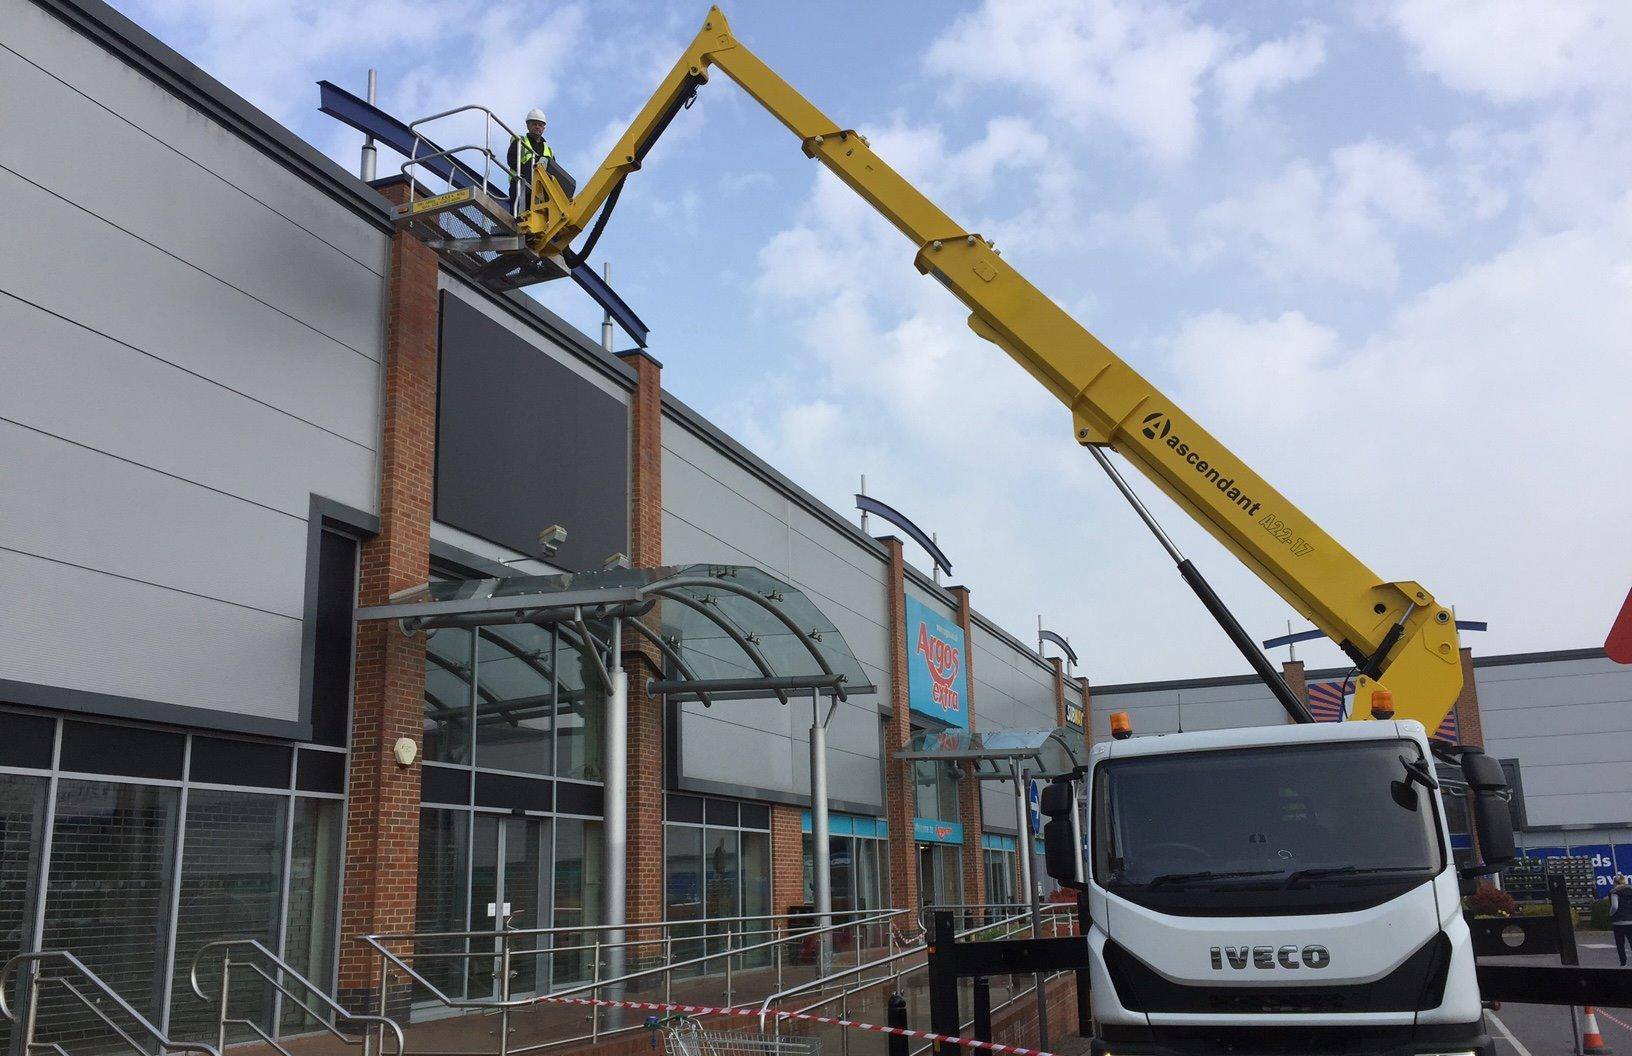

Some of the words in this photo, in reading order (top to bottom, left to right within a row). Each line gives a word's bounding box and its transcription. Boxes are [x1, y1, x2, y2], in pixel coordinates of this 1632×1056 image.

[1166, 435, 1263, 516] ascendant
[1258, 513, 1315, 557] A22-17
[916, 621, 959, 688] Argos
[933, 682, 958, 711] extra
[1210, 944, 1331, 970] IVECO
